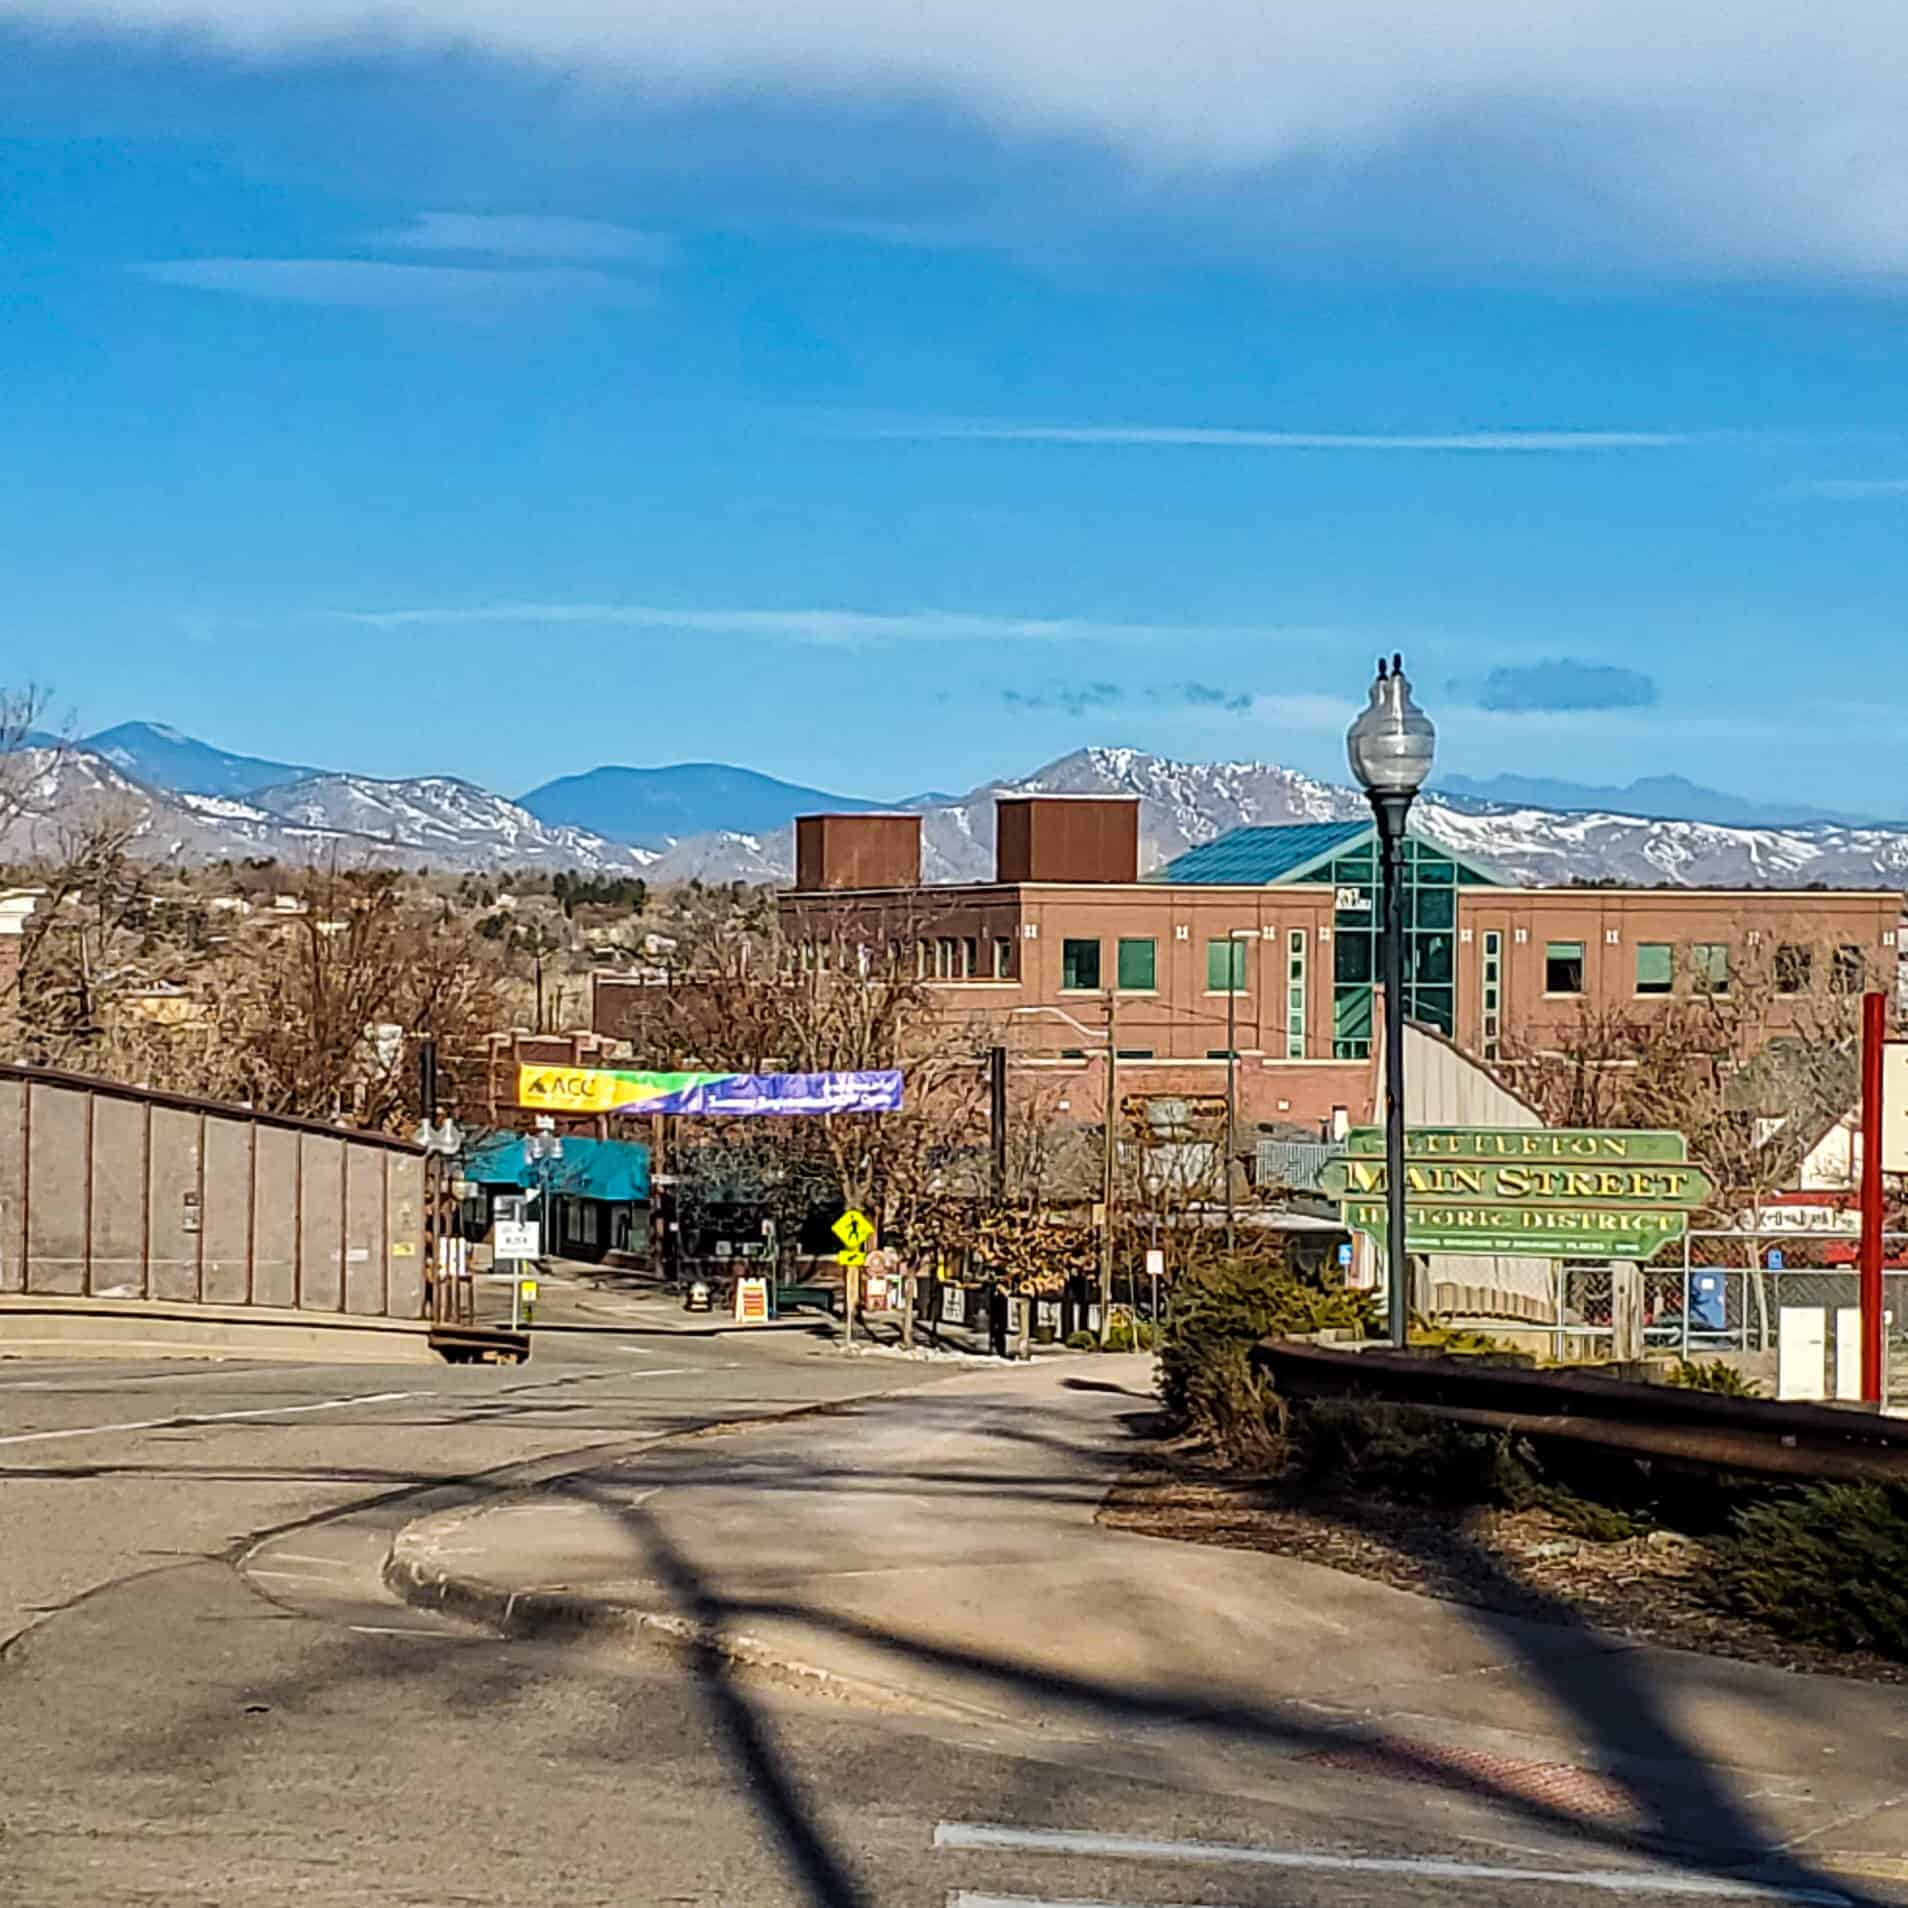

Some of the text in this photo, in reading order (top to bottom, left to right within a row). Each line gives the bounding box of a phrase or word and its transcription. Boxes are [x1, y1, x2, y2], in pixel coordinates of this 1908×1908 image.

[552, 1076, 595, 1097] ACC
[1342, 1161, 1689, 1198] MAIN STREET
[1359, 1207, 1675, 1231] HTORIC DISTRICT
